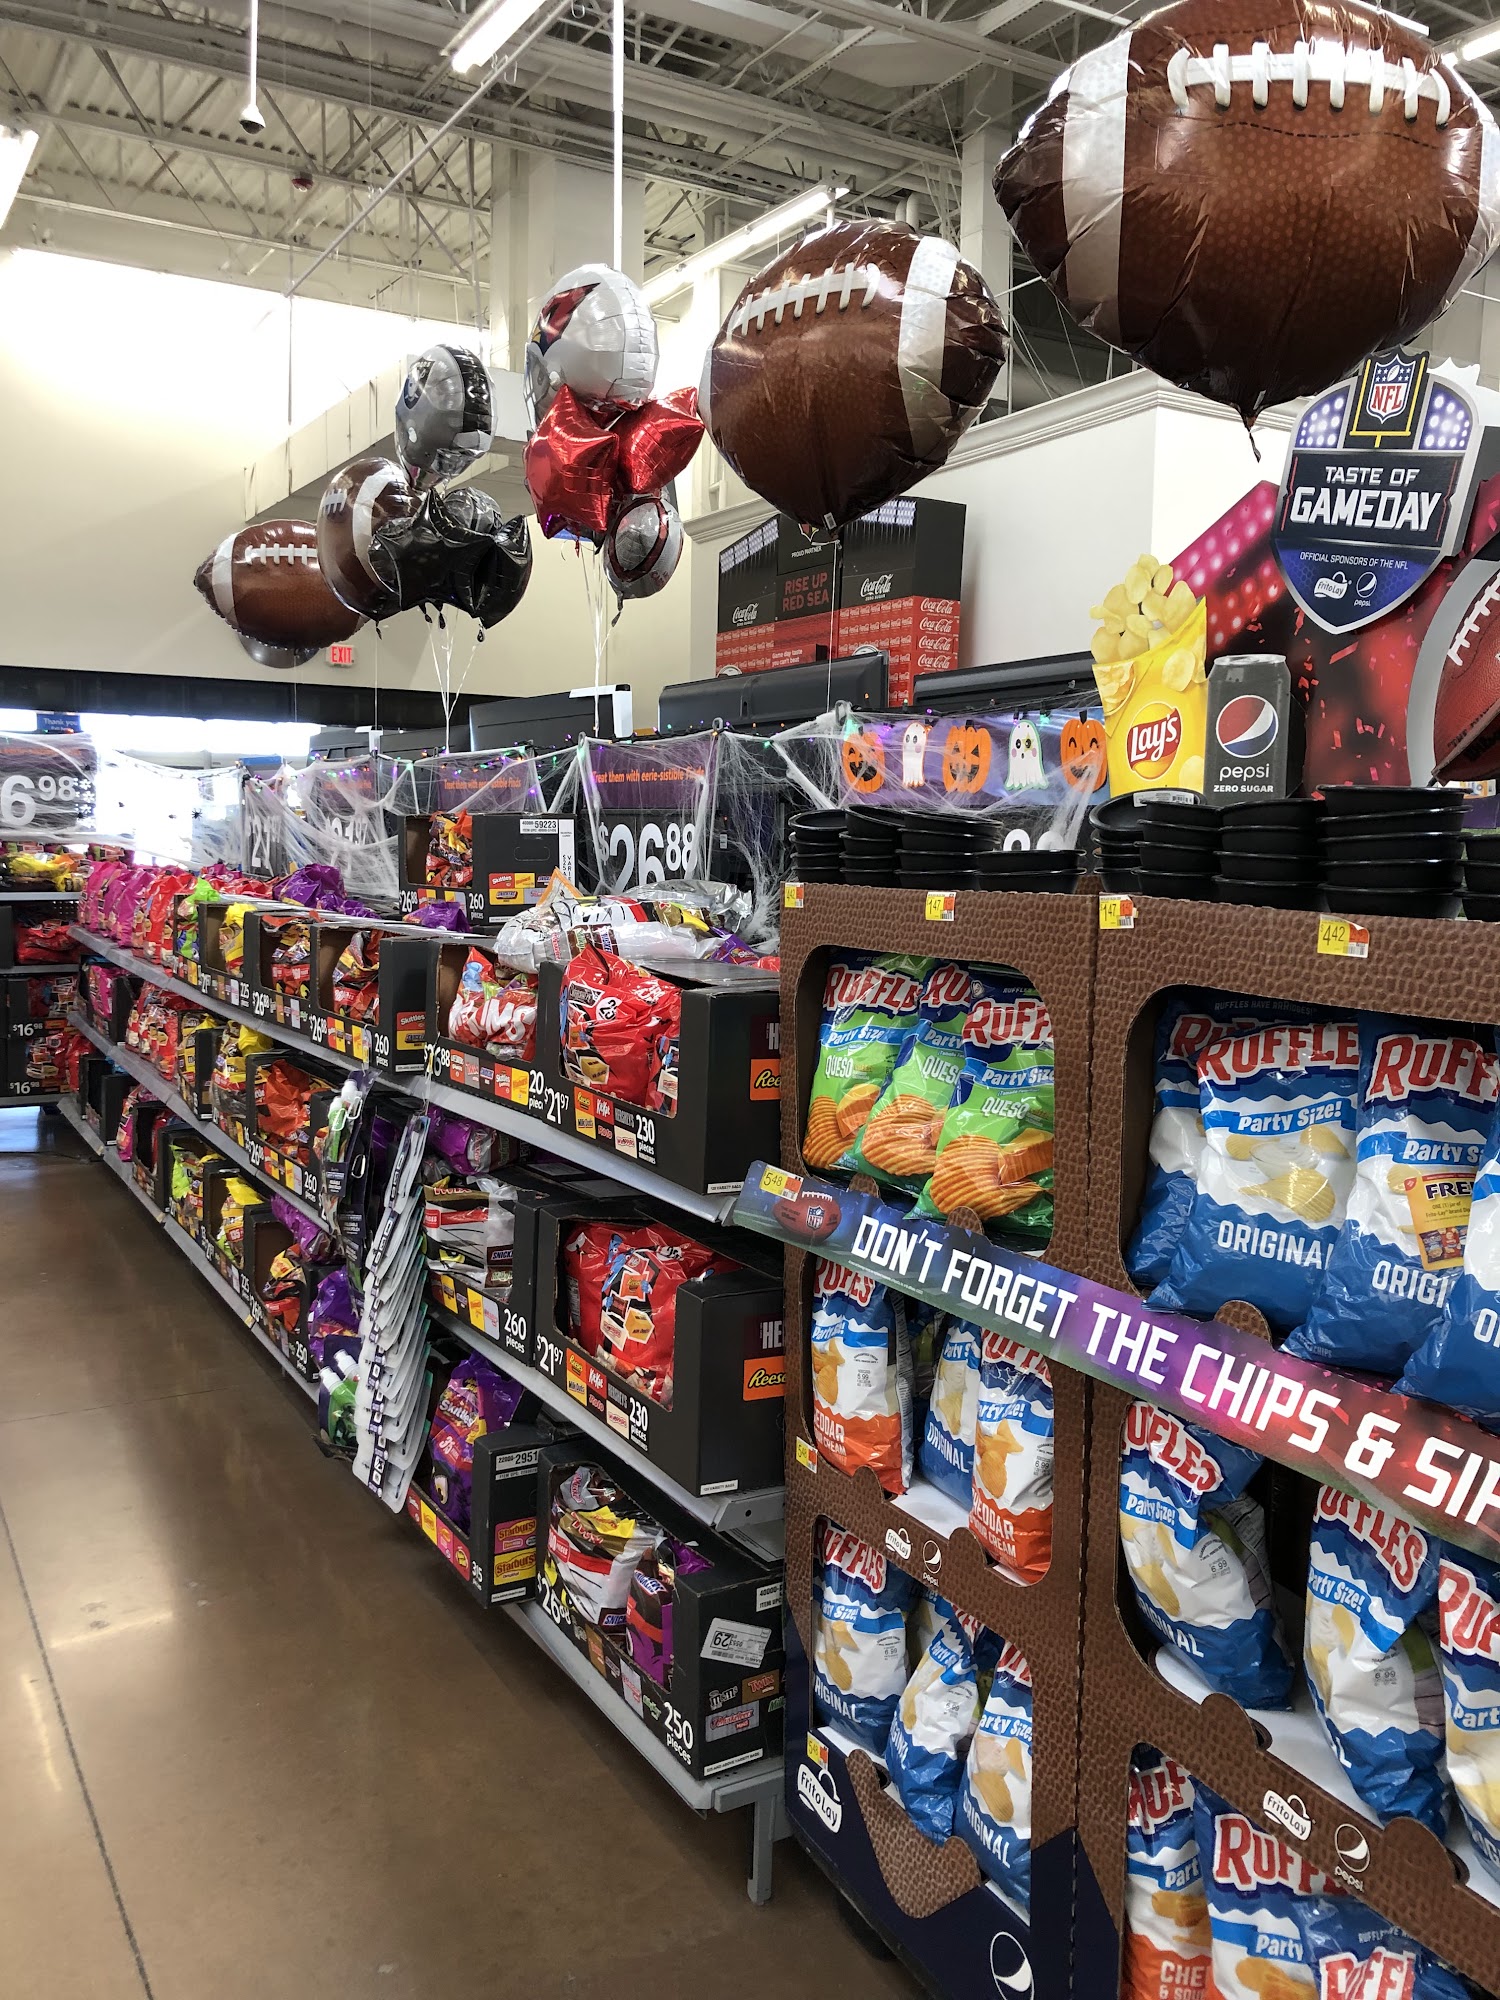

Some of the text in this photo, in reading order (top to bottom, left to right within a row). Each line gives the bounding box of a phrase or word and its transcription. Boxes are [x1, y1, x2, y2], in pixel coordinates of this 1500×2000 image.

[1372, 384, 1404, 412] NFL
[1325, 466, 1420, 486] TASTE OF
[1290, 487, 1441, 531] GAMEDAY
[791, 546, 822, 558] PROUD PARTNER
[1300, 552, 1409, 570] OFFICIAL SPONSORS OF THE NFL
[784, 572, 828, 595] RISE UP
[782, 590, 829, 612] RED SEA
[1354, 598, 1371, 607] pepsi
[331, 646, 352, 663] EXIT
[1129, 714, 1179, 761] Lay's
[608, 771, 624, 782] them
[626, 769, 640, 782] with
[1219, 762, 1270, 783] pepsi
[1213, 783, 1274, 793] ZERO SUGAR
[469, 893, 484, 910] 260
[470, 910, 484, 920] pieces
[1214, 1000, 1249, 1011] RUFFLES
[374, 1032, 390, 1056] 260
[828, 1029, 855, 1045] Party
[924, 1029, 964, 1050] Party
[825, 1056, 854, 1078] QUESO
[982, 1068, 1027, 1085] Party
[982, 1097, 1030, 1120] QUESO
[1237, 1102, 1343, 1134] Party Size!
[636, 1114, 655, 1145] 230
[638, 1141, 654, 1155] pieces
[1404, 1139, 1463, 1163] Party
[304, 1171, 317, 1193] 260
[492, 1251, 513, 1260] SNICK
[1373, 1261, 1447, 1307] ORIGI
[504, 1308, 527, 1341] 260
[506, 1335, 525, 1354] pieces
[851, 1215, 943, 1283] DON'T
[941, 1247, 1078, 1339] FORGET
[1086, 1302, 1179, 1384] THE
[1180, 1342, 1341, 1454] CHIPS
[1344, 1411, 1401, 1479] &
[440, 1400, 474, 1428] Skittles
[630, 1397, 648, 1431] 230
[631, 1424, 647, 1442] pieces
[823, 1437, 847, 1457] CREAM
[926, 1422, 970, 1473] ORIGINAL
[1124, 1402, 1221, 1493] UFFLES
[972, 1491, 1015, 1542] HEDDAR
[1126, 1493, 1176, 1525] Party Size!
[988, 1534, 1017, 1558] CREAM
[1316, 1487, 1427, 1592] UFFLES
[922, 1571, 939, 1587] pepsi
[1307, 1570, 1366, 1613] Party Size!
[605, 1614, 627, 1625] SNICK
[834, 1603, 859, 1621] Size!
[814, 1678, 861, 1724] RIGINAL
[663, 1702, 694, 1750] 250
[980, 1716, 1012, 1733] arty
[667, 1732, 692, 1765] pieces
[1334, 1866, 1366, 1893] pepsi
[1255, 1934, 1304, 1962] Party
